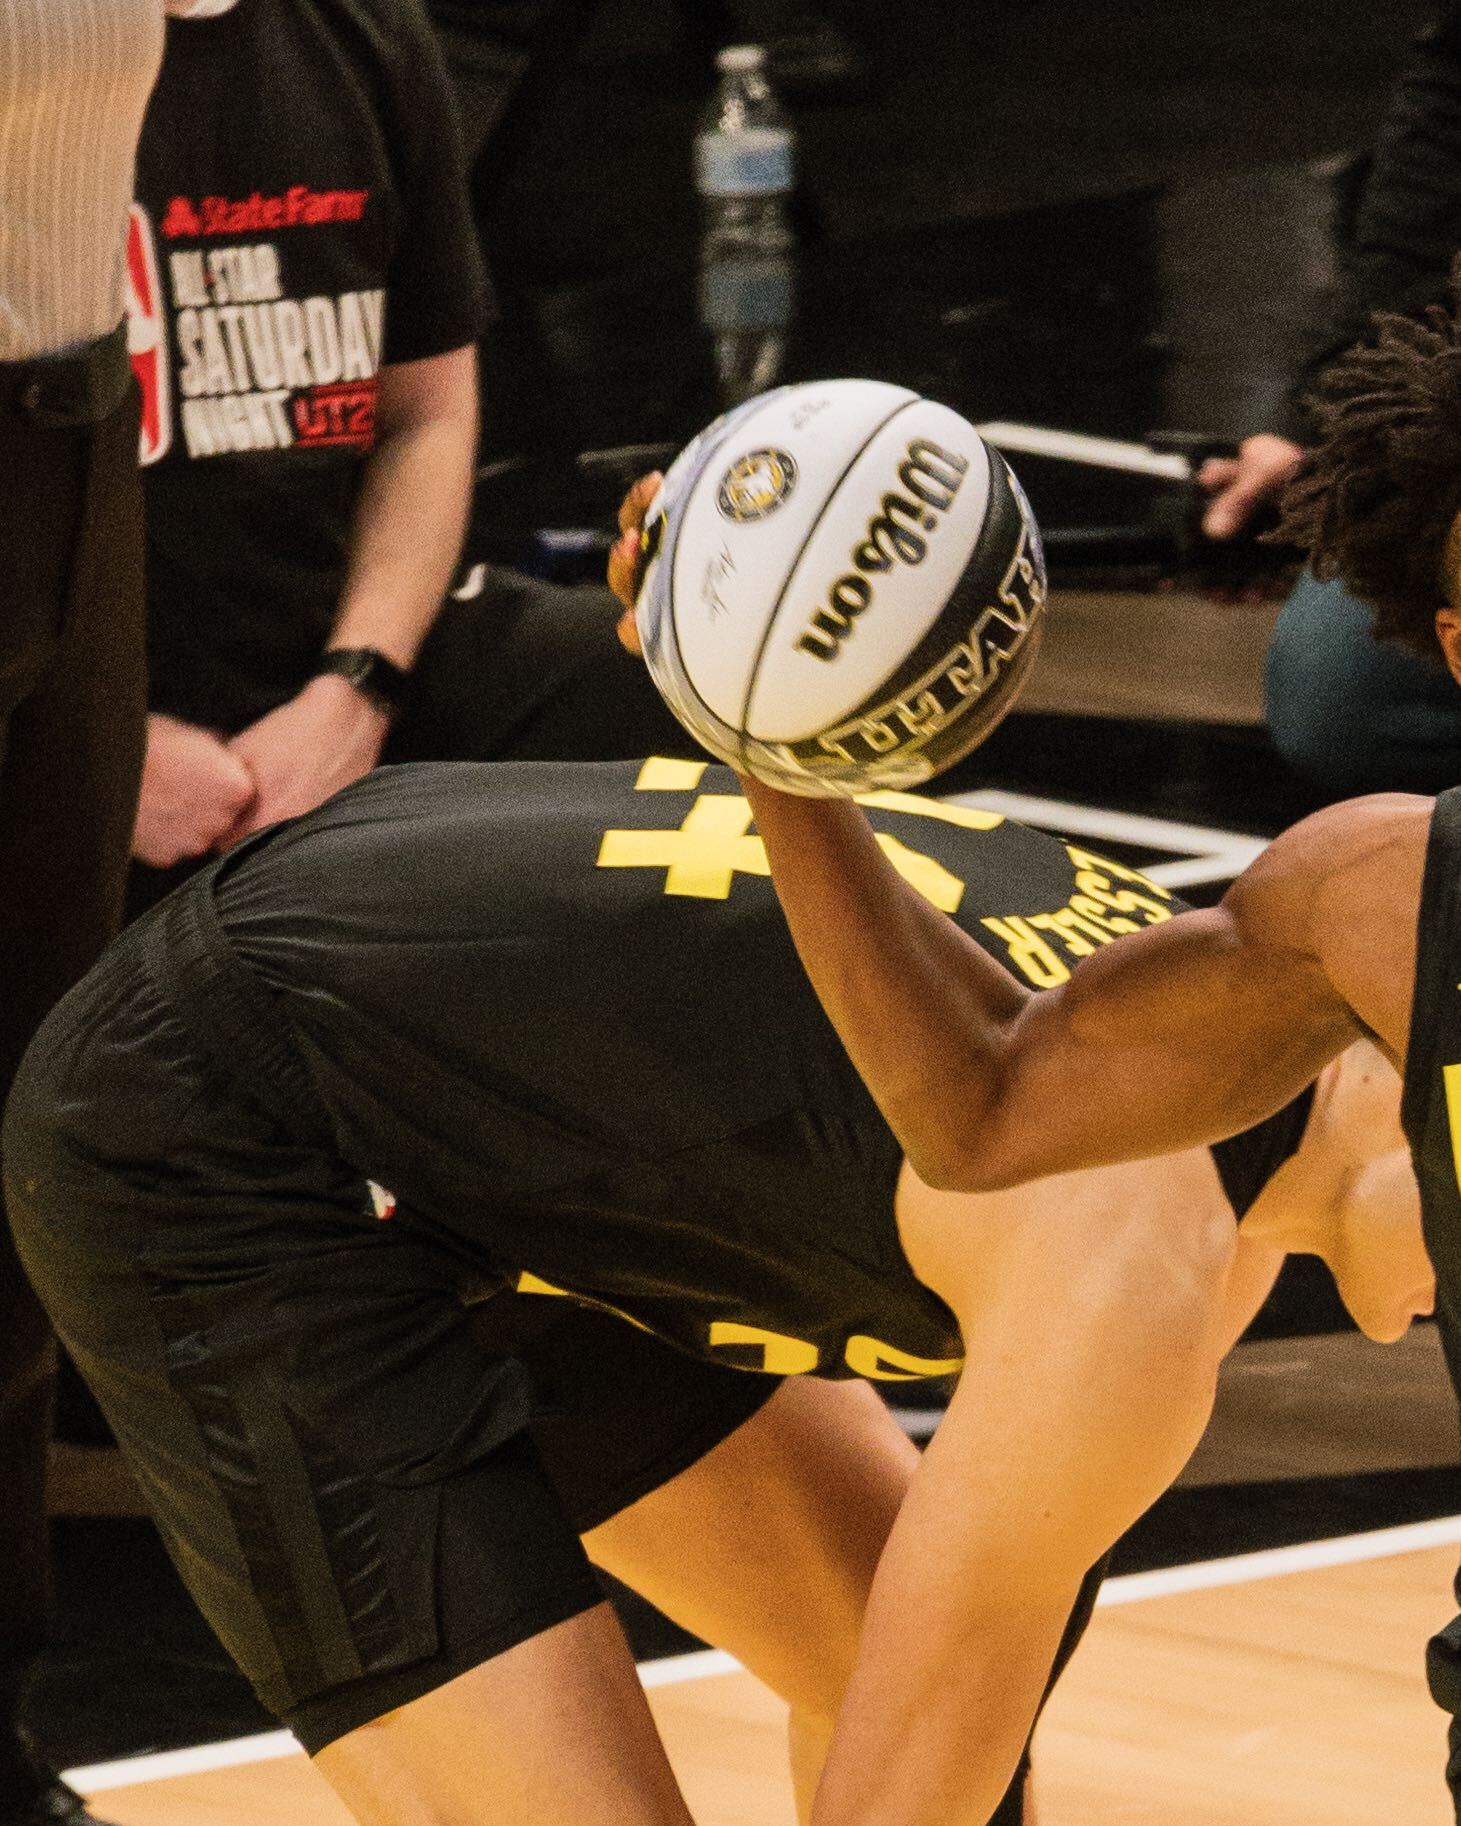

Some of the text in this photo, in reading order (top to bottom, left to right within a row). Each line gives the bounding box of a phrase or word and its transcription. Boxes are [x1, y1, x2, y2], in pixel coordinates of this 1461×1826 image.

[177, 289, 386, 399] SATURDAY
[181, 389, 293, 459] NIGHT
[792, 438, 971, 663] Wilson
